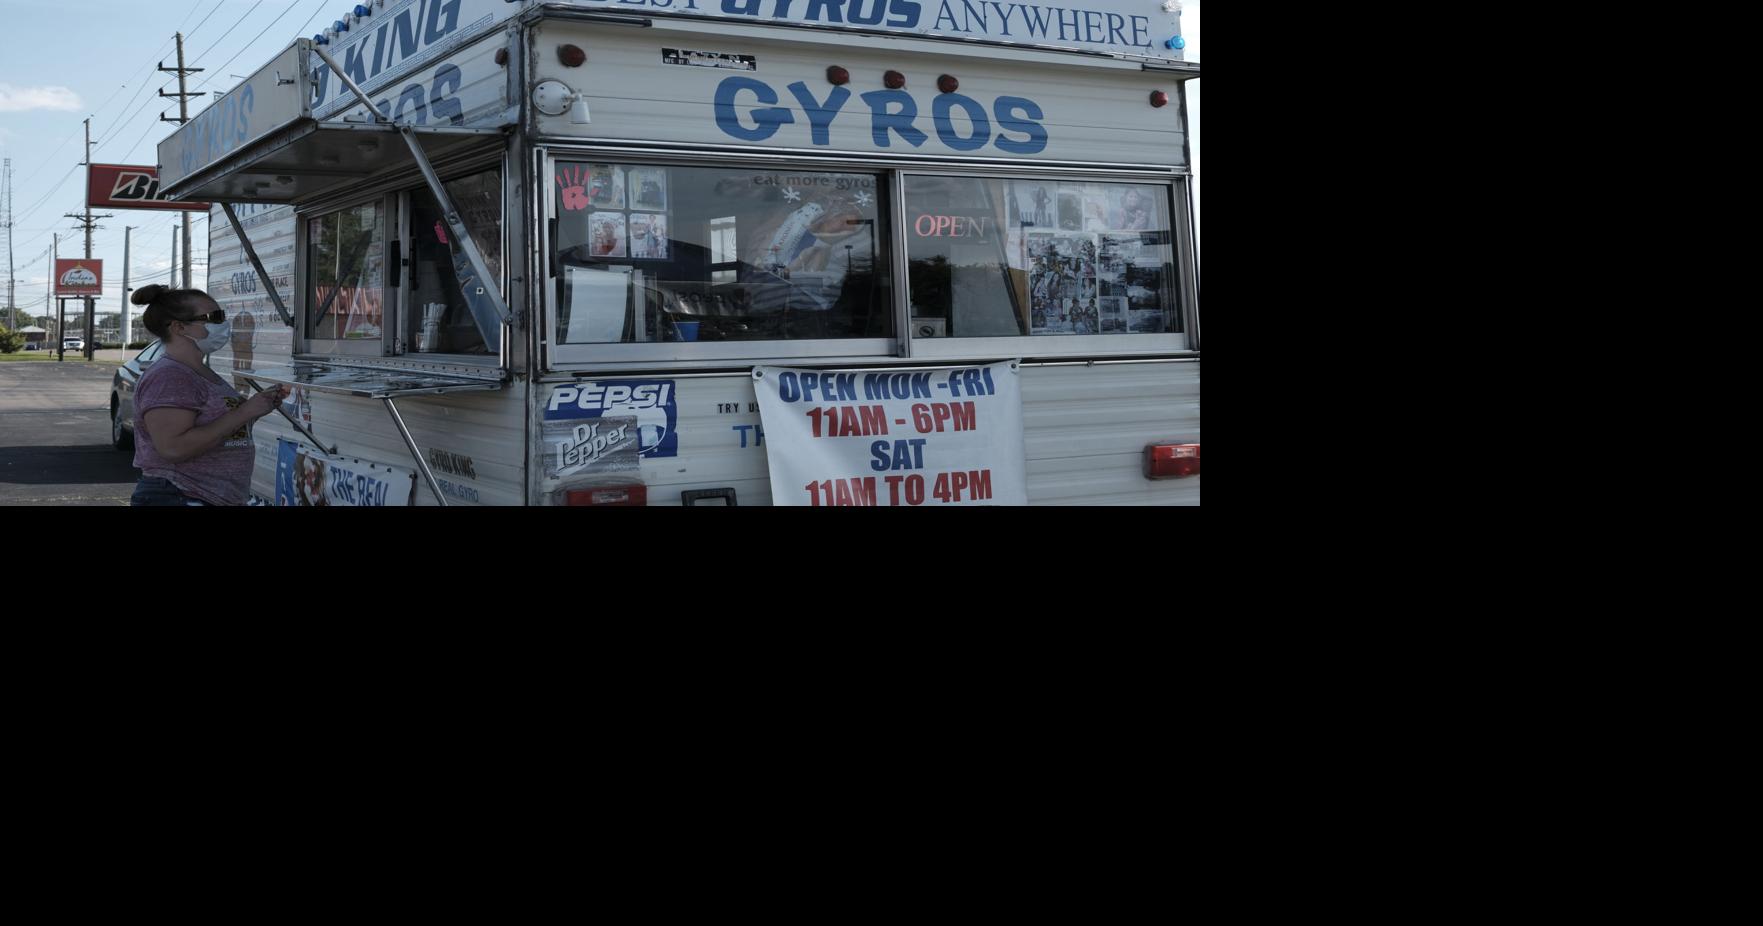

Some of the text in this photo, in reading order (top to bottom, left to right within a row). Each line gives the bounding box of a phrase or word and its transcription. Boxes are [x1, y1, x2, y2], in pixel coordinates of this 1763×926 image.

[933, 0, 1154, 49] ANYWHERE
[340, 0, 461, 95] KING
[714, 75, 1049, 155] GYROS
[753, 173, 780, 187] eat
[785, 174, 829, 187] more
[914, 213, 986, 239] OPEN
[231, 270, 257, 295] GYROS
[548, 383, 671, 411] PEPSI
[778, 371, 858, 403] OPEN
[864, 372, 932, 401] MON
[718, 403, 739, 414] TRY
[806, 404, 889, 438] 11AM
[911, 400, 977, 434] 6PM
[556, 423, 629, 472] Pepper
[573, 422, 600, 447] Dr
[870, 438, 927, 471] SAT
[330, 465, 357, 505] THE
[805, 469, 992, 506] 11AM TO 4PM
